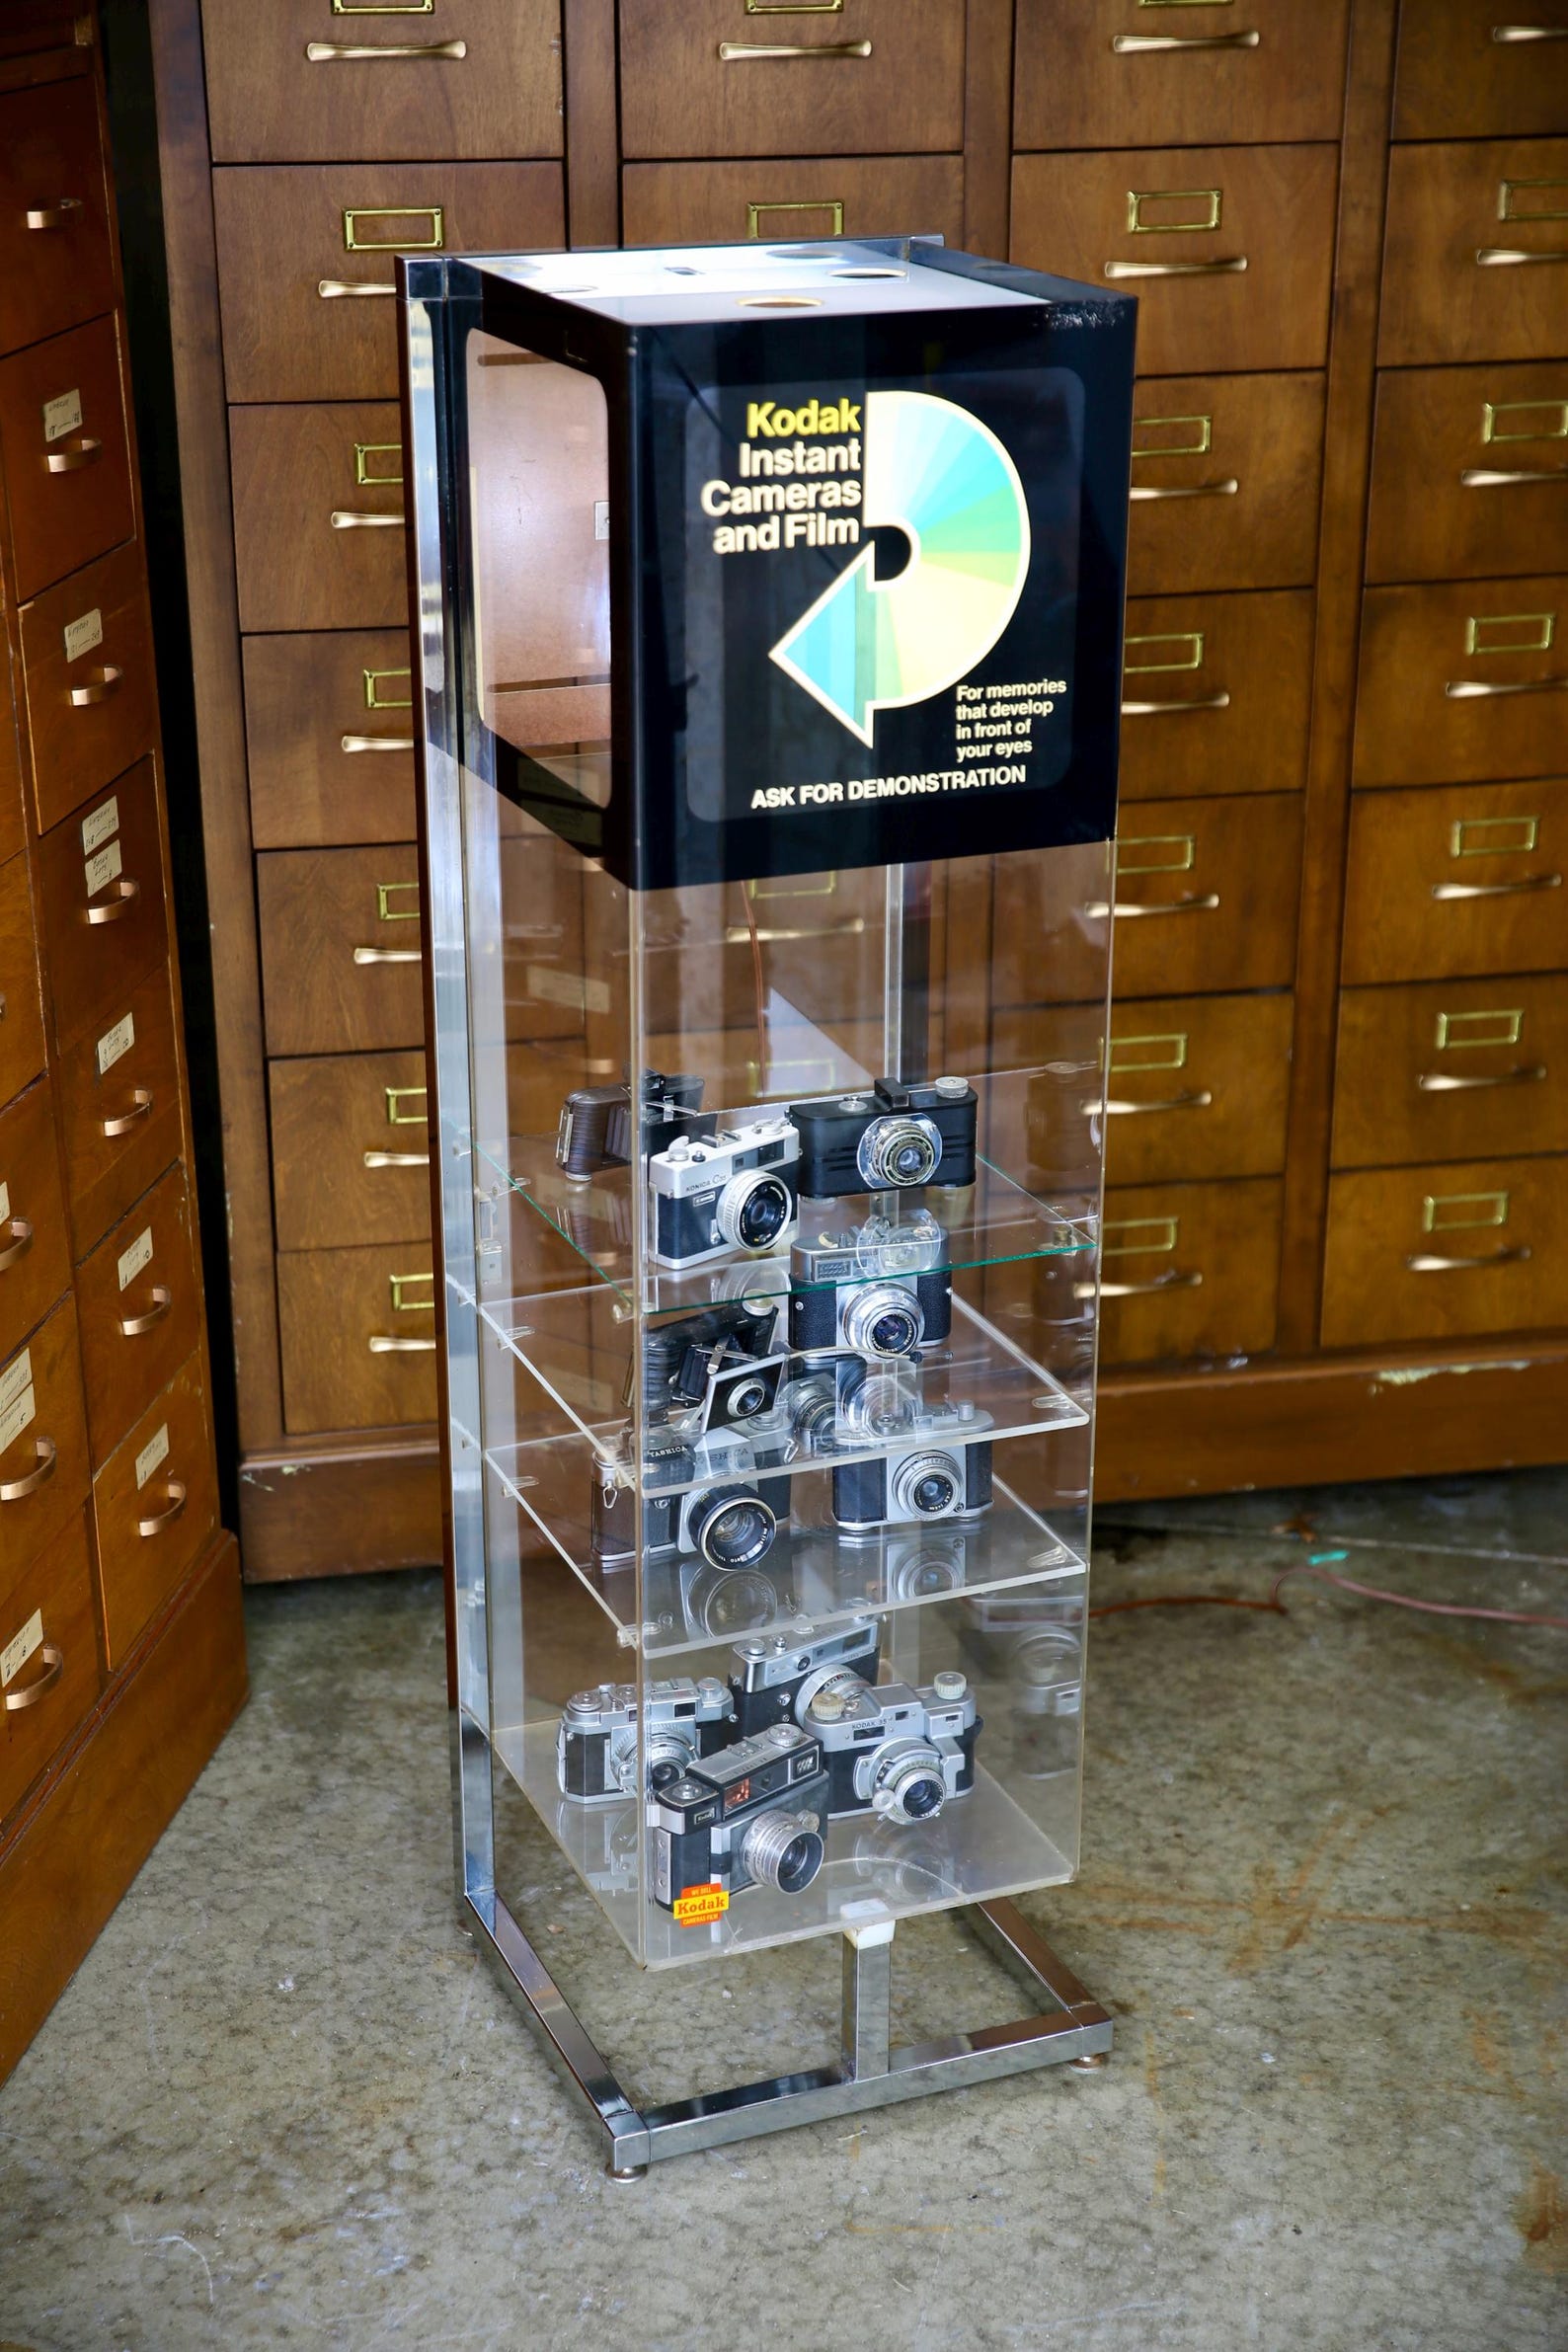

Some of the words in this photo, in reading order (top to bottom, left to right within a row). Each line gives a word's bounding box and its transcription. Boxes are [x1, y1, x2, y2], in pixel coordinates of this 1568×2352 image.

[746, 398, 862, 438] Kodak
[740, 437, 862, 478] Instant
[700, 479, 862, 517] Cameras
[712, 514, 780, 555] and
[784, 511, 860, 549] Film
[956, 684, 984, 702] For
[985, 678, 1067, 700] memories
[955, 703, 987, 721] that
[988, 698, 1054, 720] develop
[956, 724, 972, 740] in
[974, 720, 1012, 739] front
[1014, 718, 1032, 735] of
[956, 744, 993, 763] your
[994, 740, 1033, 759] eyes
[750, 786, 796, 810] ASK
[799, 781, 844, 805] FOR
[847, 764, 1027, 801] DEMONSTRATION
[685, 1180, 712, 1193] KONICA
[851, 1721, 876, 1730] KODAK
[677, 1896, 725, 1916] Kodak
